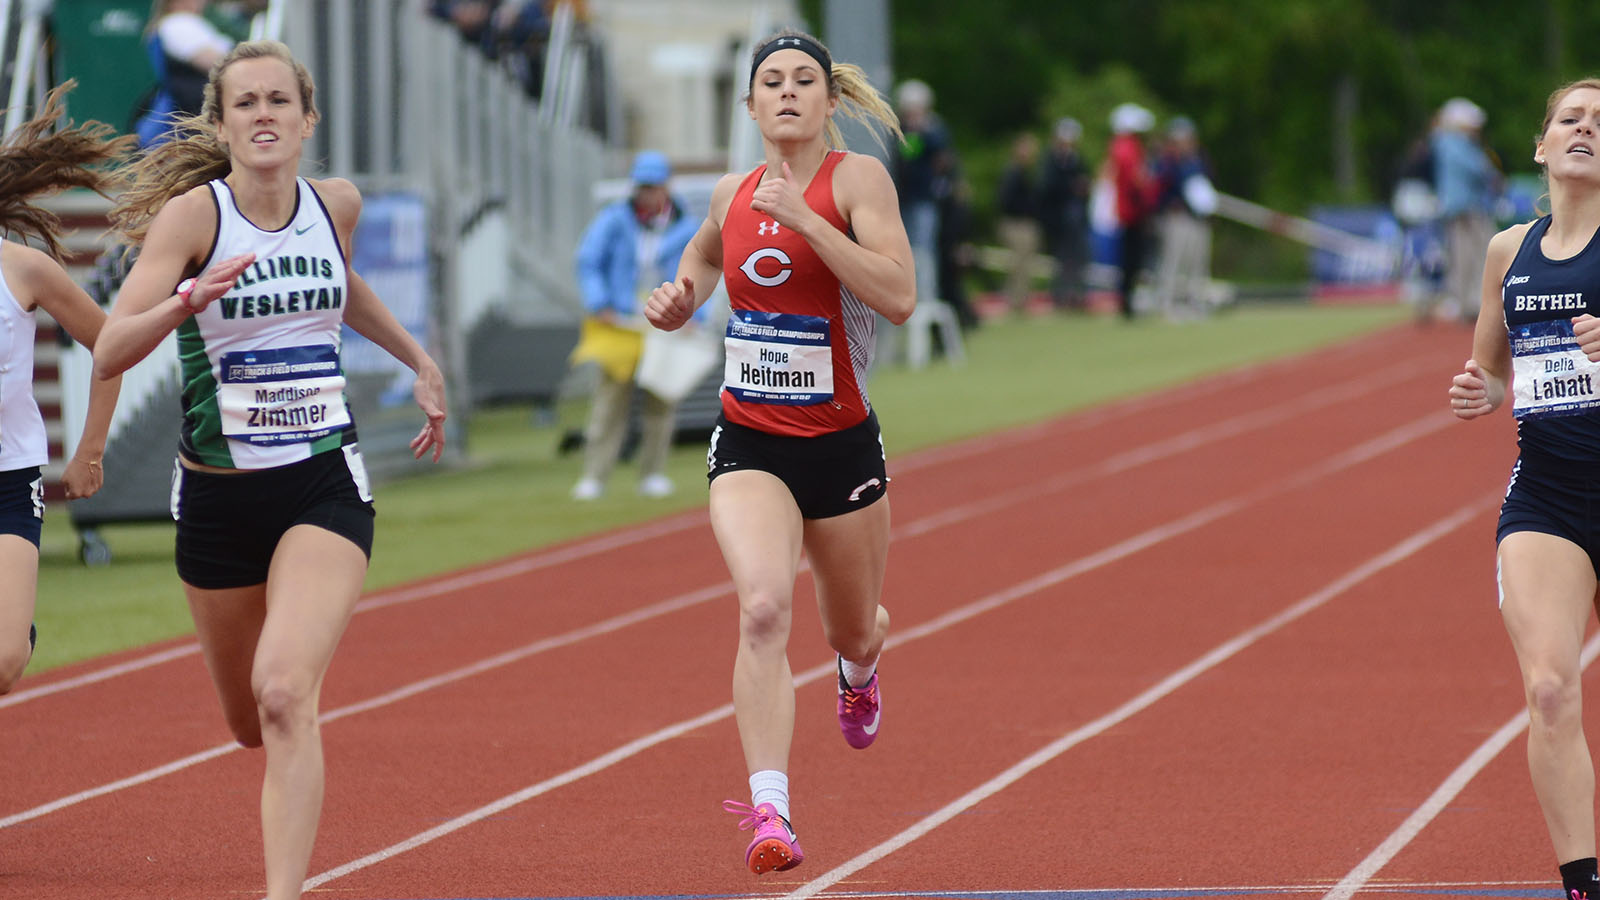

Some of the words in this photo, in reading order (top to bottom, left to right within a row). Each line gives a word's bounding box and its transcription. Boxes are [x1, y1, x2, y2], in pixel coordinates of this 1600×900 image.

[220, 287, 342, 319] WESLEYAN
[1514, 293, 1587, 311] BETHEL
[762, 328, 777, 337] FIELD
[760, 348, 789, 364] Hope
[1545, 358, 1574, 373] Delia
[741, 362, 815, 388] Heitman
[255, 387, 321, 403] Maddison
[1533, 374, 1593, 401] Labatt
[247, 404, 327, 427] Zimmer
